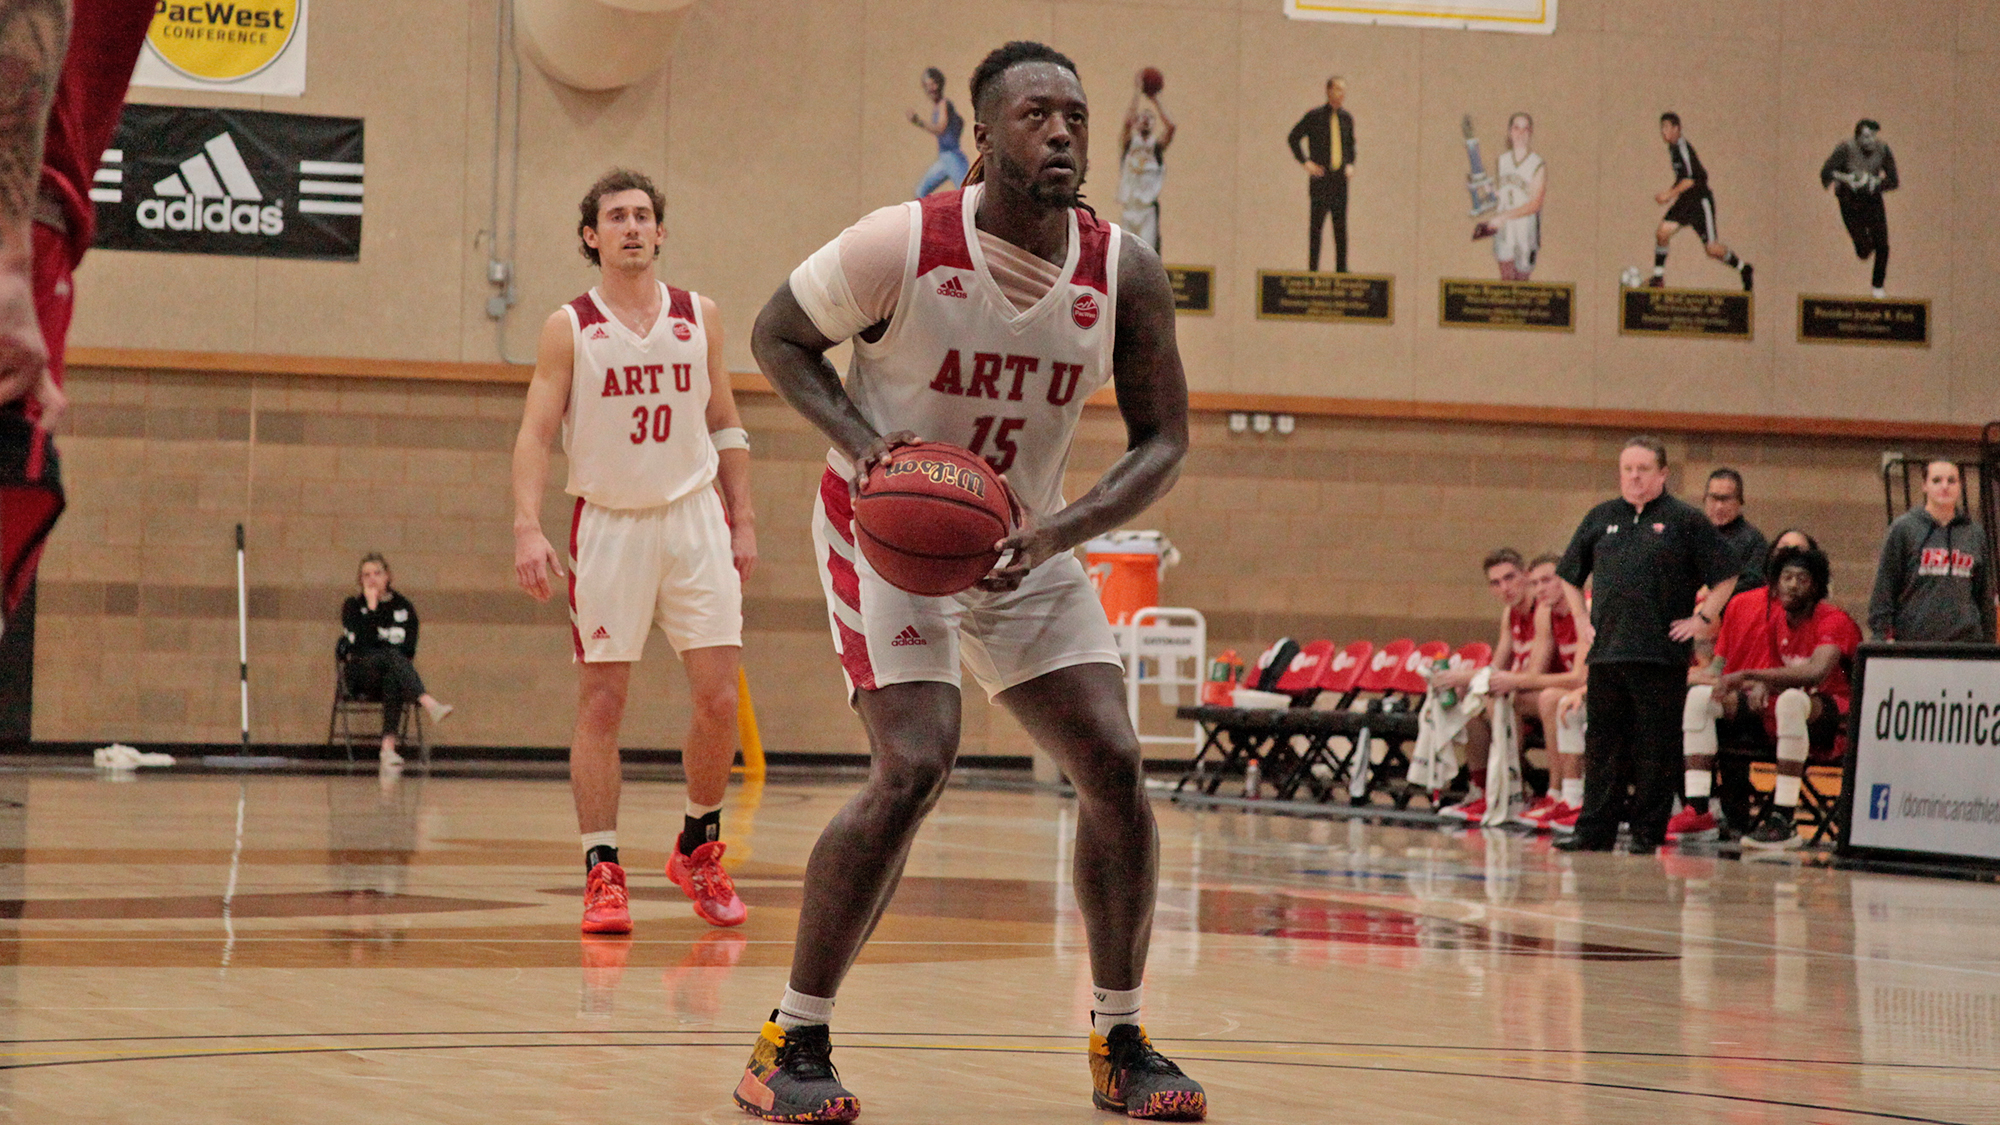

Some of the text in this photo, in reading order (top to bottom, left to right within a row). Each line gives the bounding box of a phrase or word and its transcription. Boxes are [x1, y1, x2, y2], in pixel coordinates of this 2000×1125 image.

[163, 25, 268, 44] CONFERENCE
[136, 193, 284, 236] adidas
[936, 287, 968, 300] adidas
[601, 363, 691, 397] ART U
[929, 348, 1084, 406] ART U
[630, 404, 672, 444] 30
[968, 415, 1027, 474] 15
[884, 460, 985, 500] Wilson
[891, 636, 927, 647] adidas
